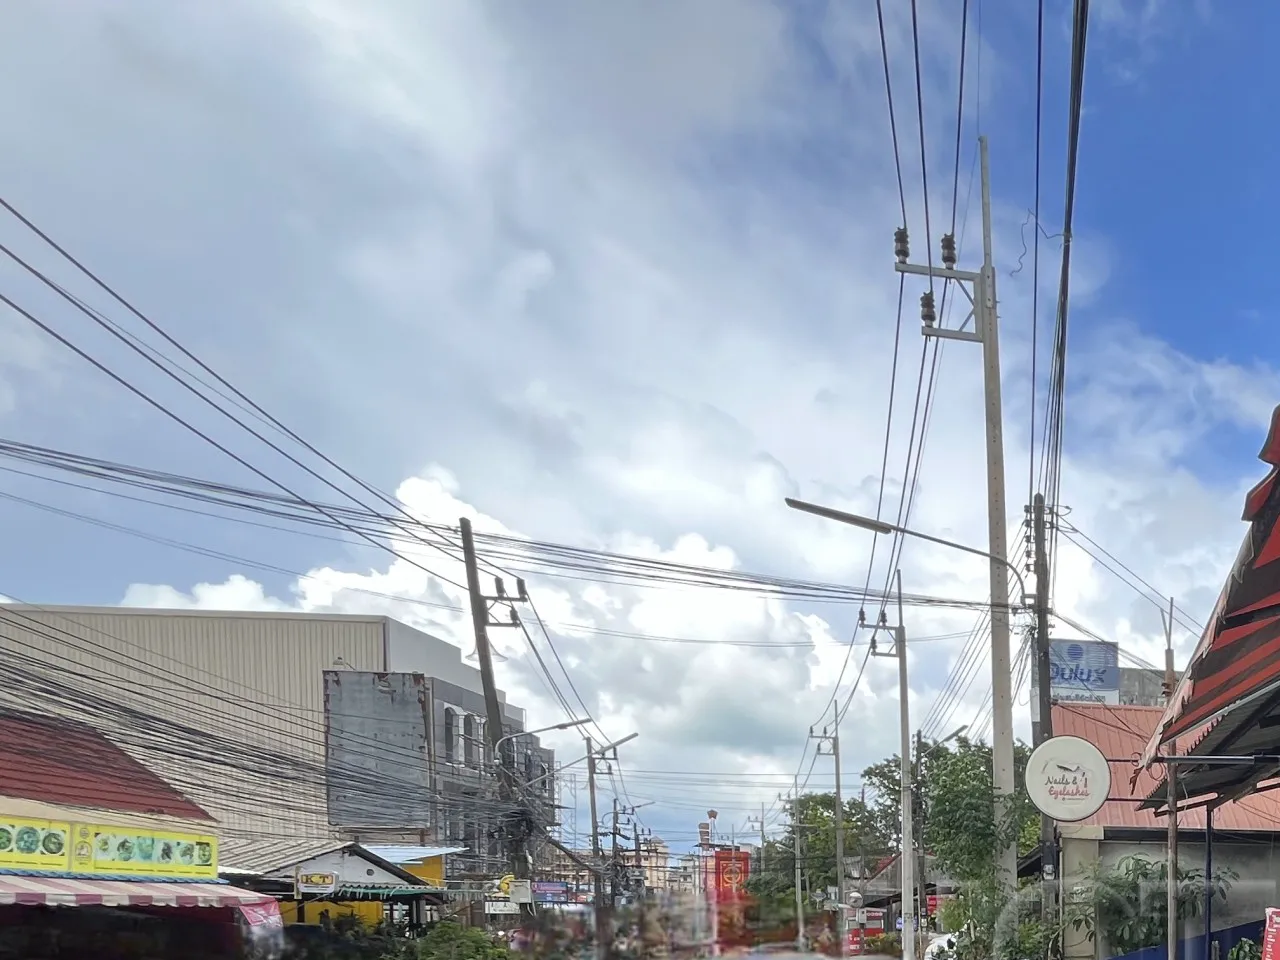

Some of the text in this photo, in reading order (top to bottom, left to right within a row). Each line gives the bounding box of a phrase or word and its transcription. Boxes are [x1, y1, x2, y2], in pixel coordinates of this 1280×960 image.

[1050, 662, 1107, 683] Dulux
[1045, 774, 1077, 785] Nails &
[1048, 786, 1090, 800] Eyelashes
